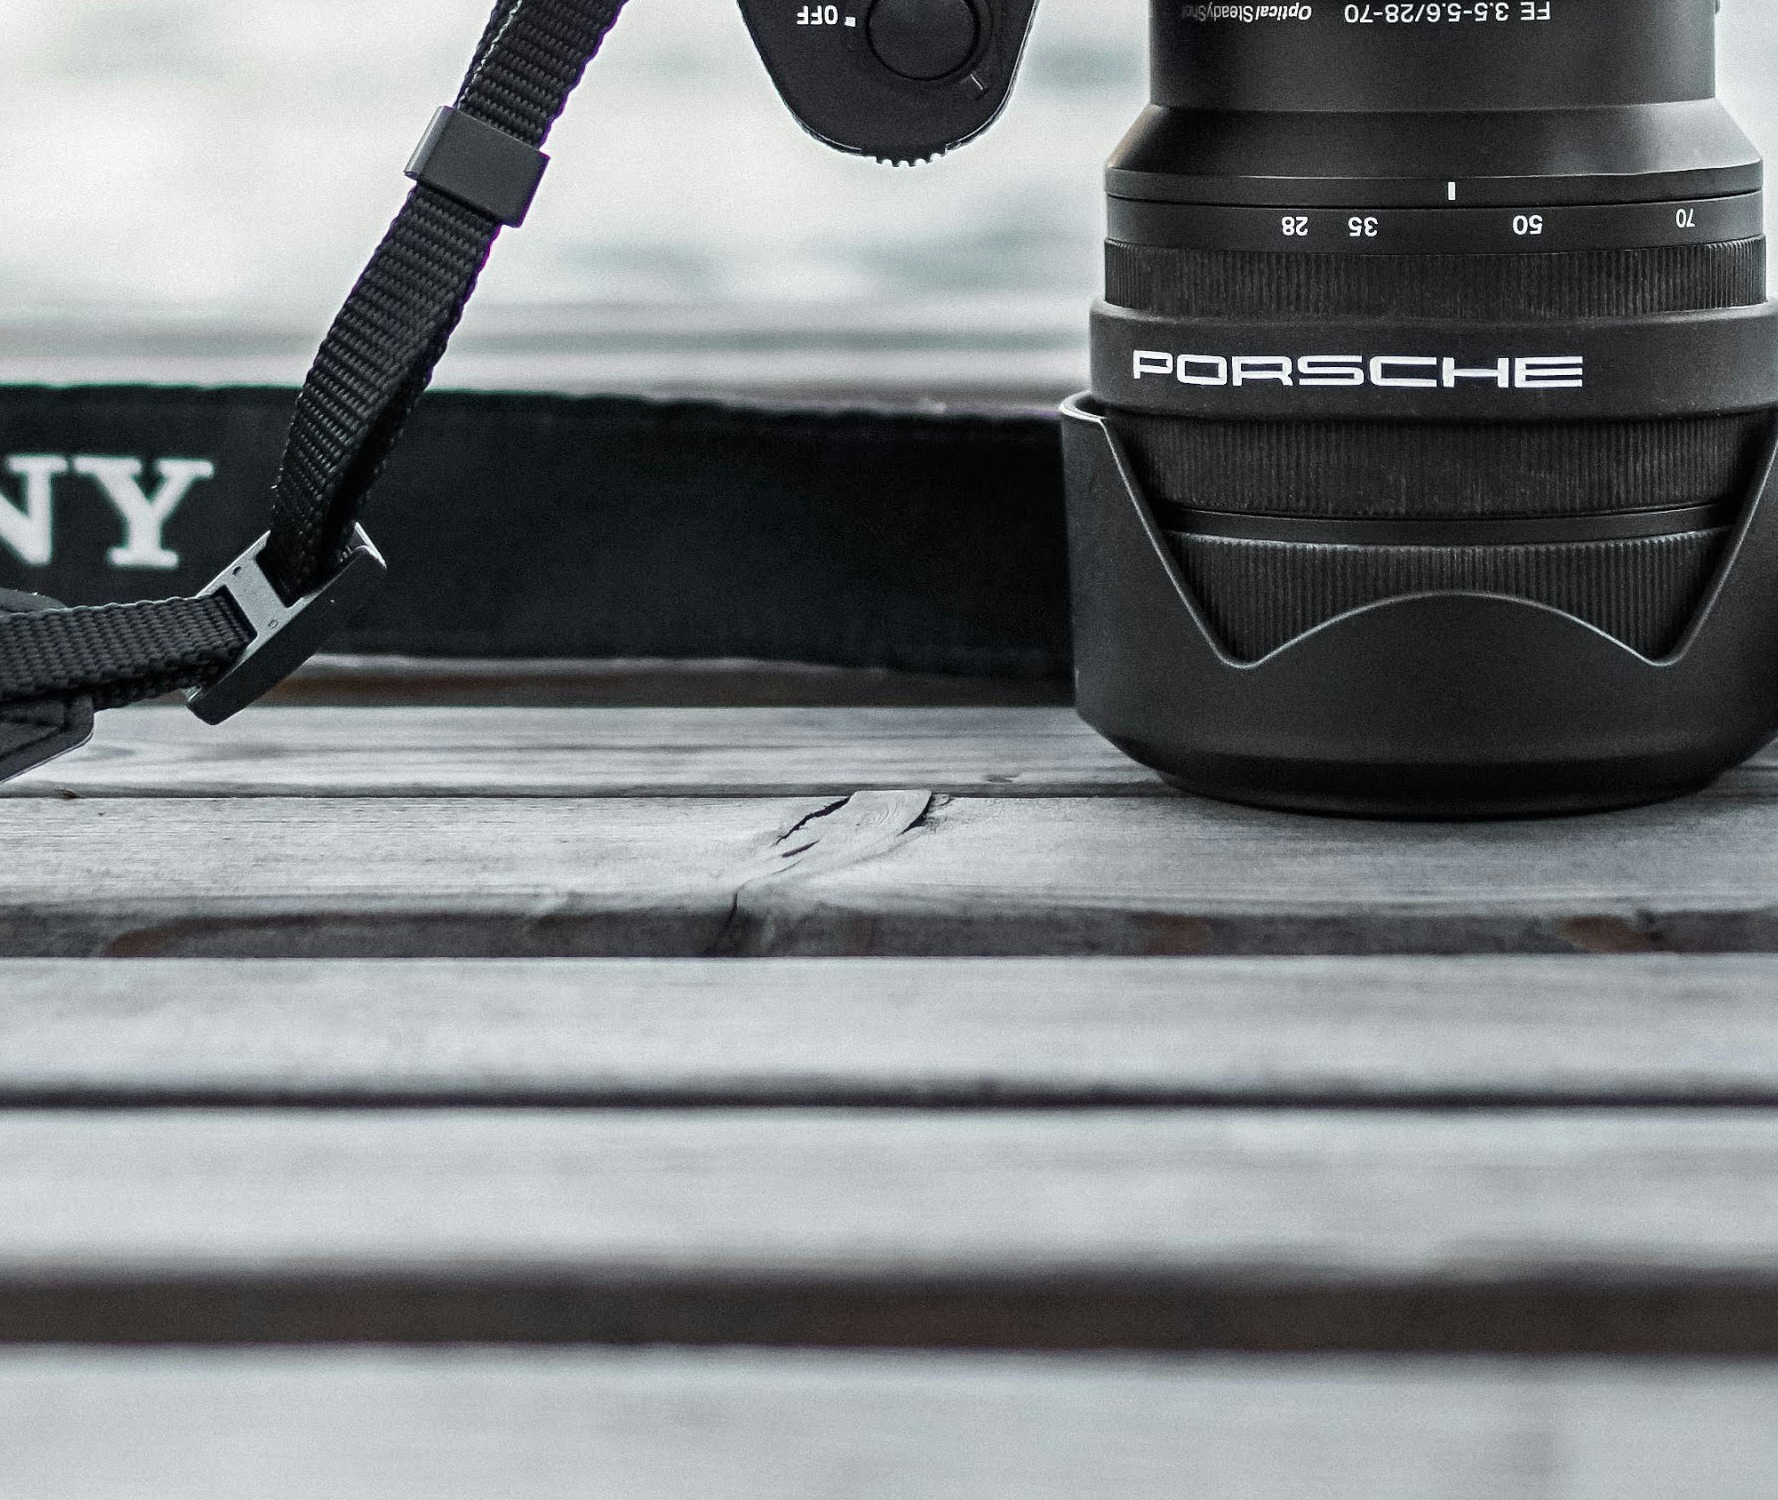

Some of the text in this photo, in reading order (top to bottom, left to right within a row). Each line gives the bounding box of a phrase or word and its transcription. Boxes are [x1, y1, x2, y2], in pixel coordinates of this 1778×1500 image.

[796, 4, 838, 26] OFF
[1343, 1, 1510, 25] 3.5-5.6/28-70
[1520, 1, 1551, 21] FE
[1281, 215, 1309, 238] 28
[1347, 215, 1379, 238] 35
[1512, 213, 1544, 236] 50
[1675, 207, 1696, 229] 70
[1132, 348, 1584, 389] PORSCHE
